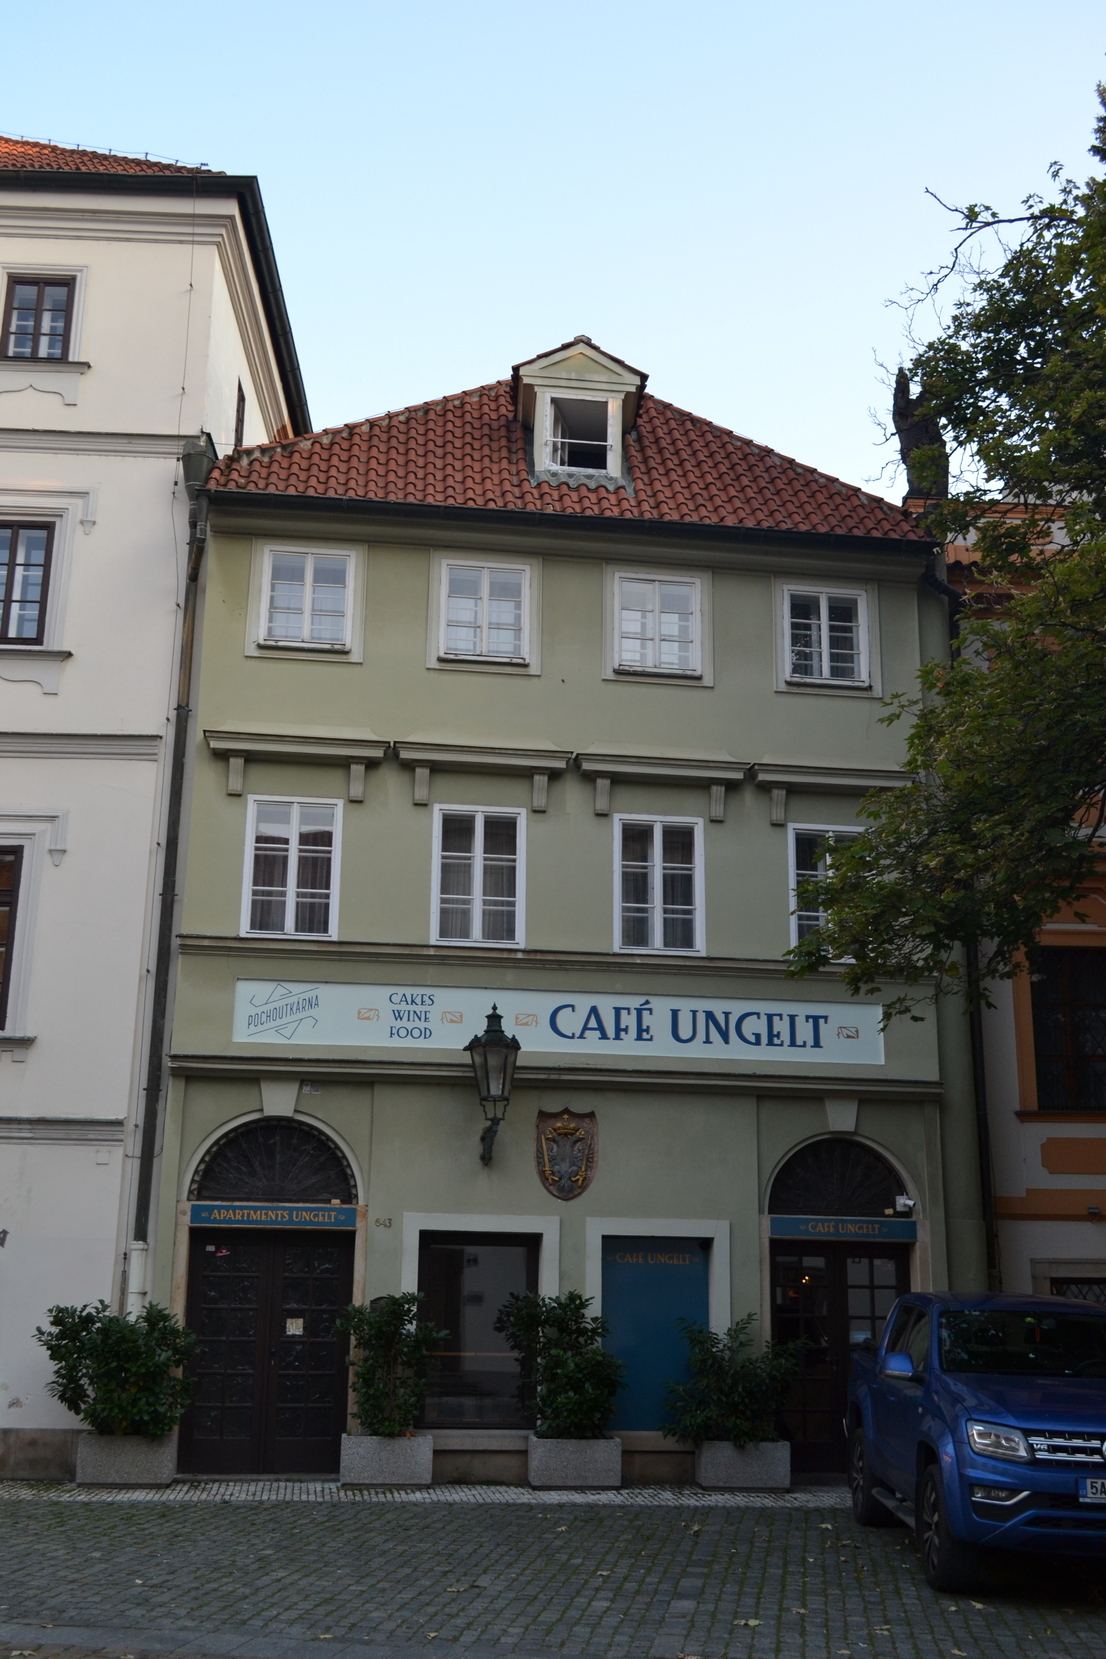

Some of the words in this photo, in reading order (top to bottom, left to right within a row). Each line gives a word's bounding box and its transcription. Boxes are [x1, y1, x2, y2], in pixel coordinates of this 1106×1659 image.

[389, 993, 435, 1006] CAKES
[248, 994, 319, 1029] POCHOUTKÁRNA
[392, 1009, 431, 1023] WINE
[549, 999, 653, 1041] CAFÉ
[669, 1008, 829, 1048] UNGELT
[389, 1026, 432, 1040] FOOD
[210, 1209, 289, 1221] APARTMENTS
[292, 1211, 337, 1222] UNGELT
[374, 1218, 392, 1228] 643
[808, 1221, 835, 1233] CAFÉ
[838, 1222, 881, 1234] UNGELT
[615, 1251, 644, 1263] CAFÉ
[648, 1253, 691, 1264] UNGELT
